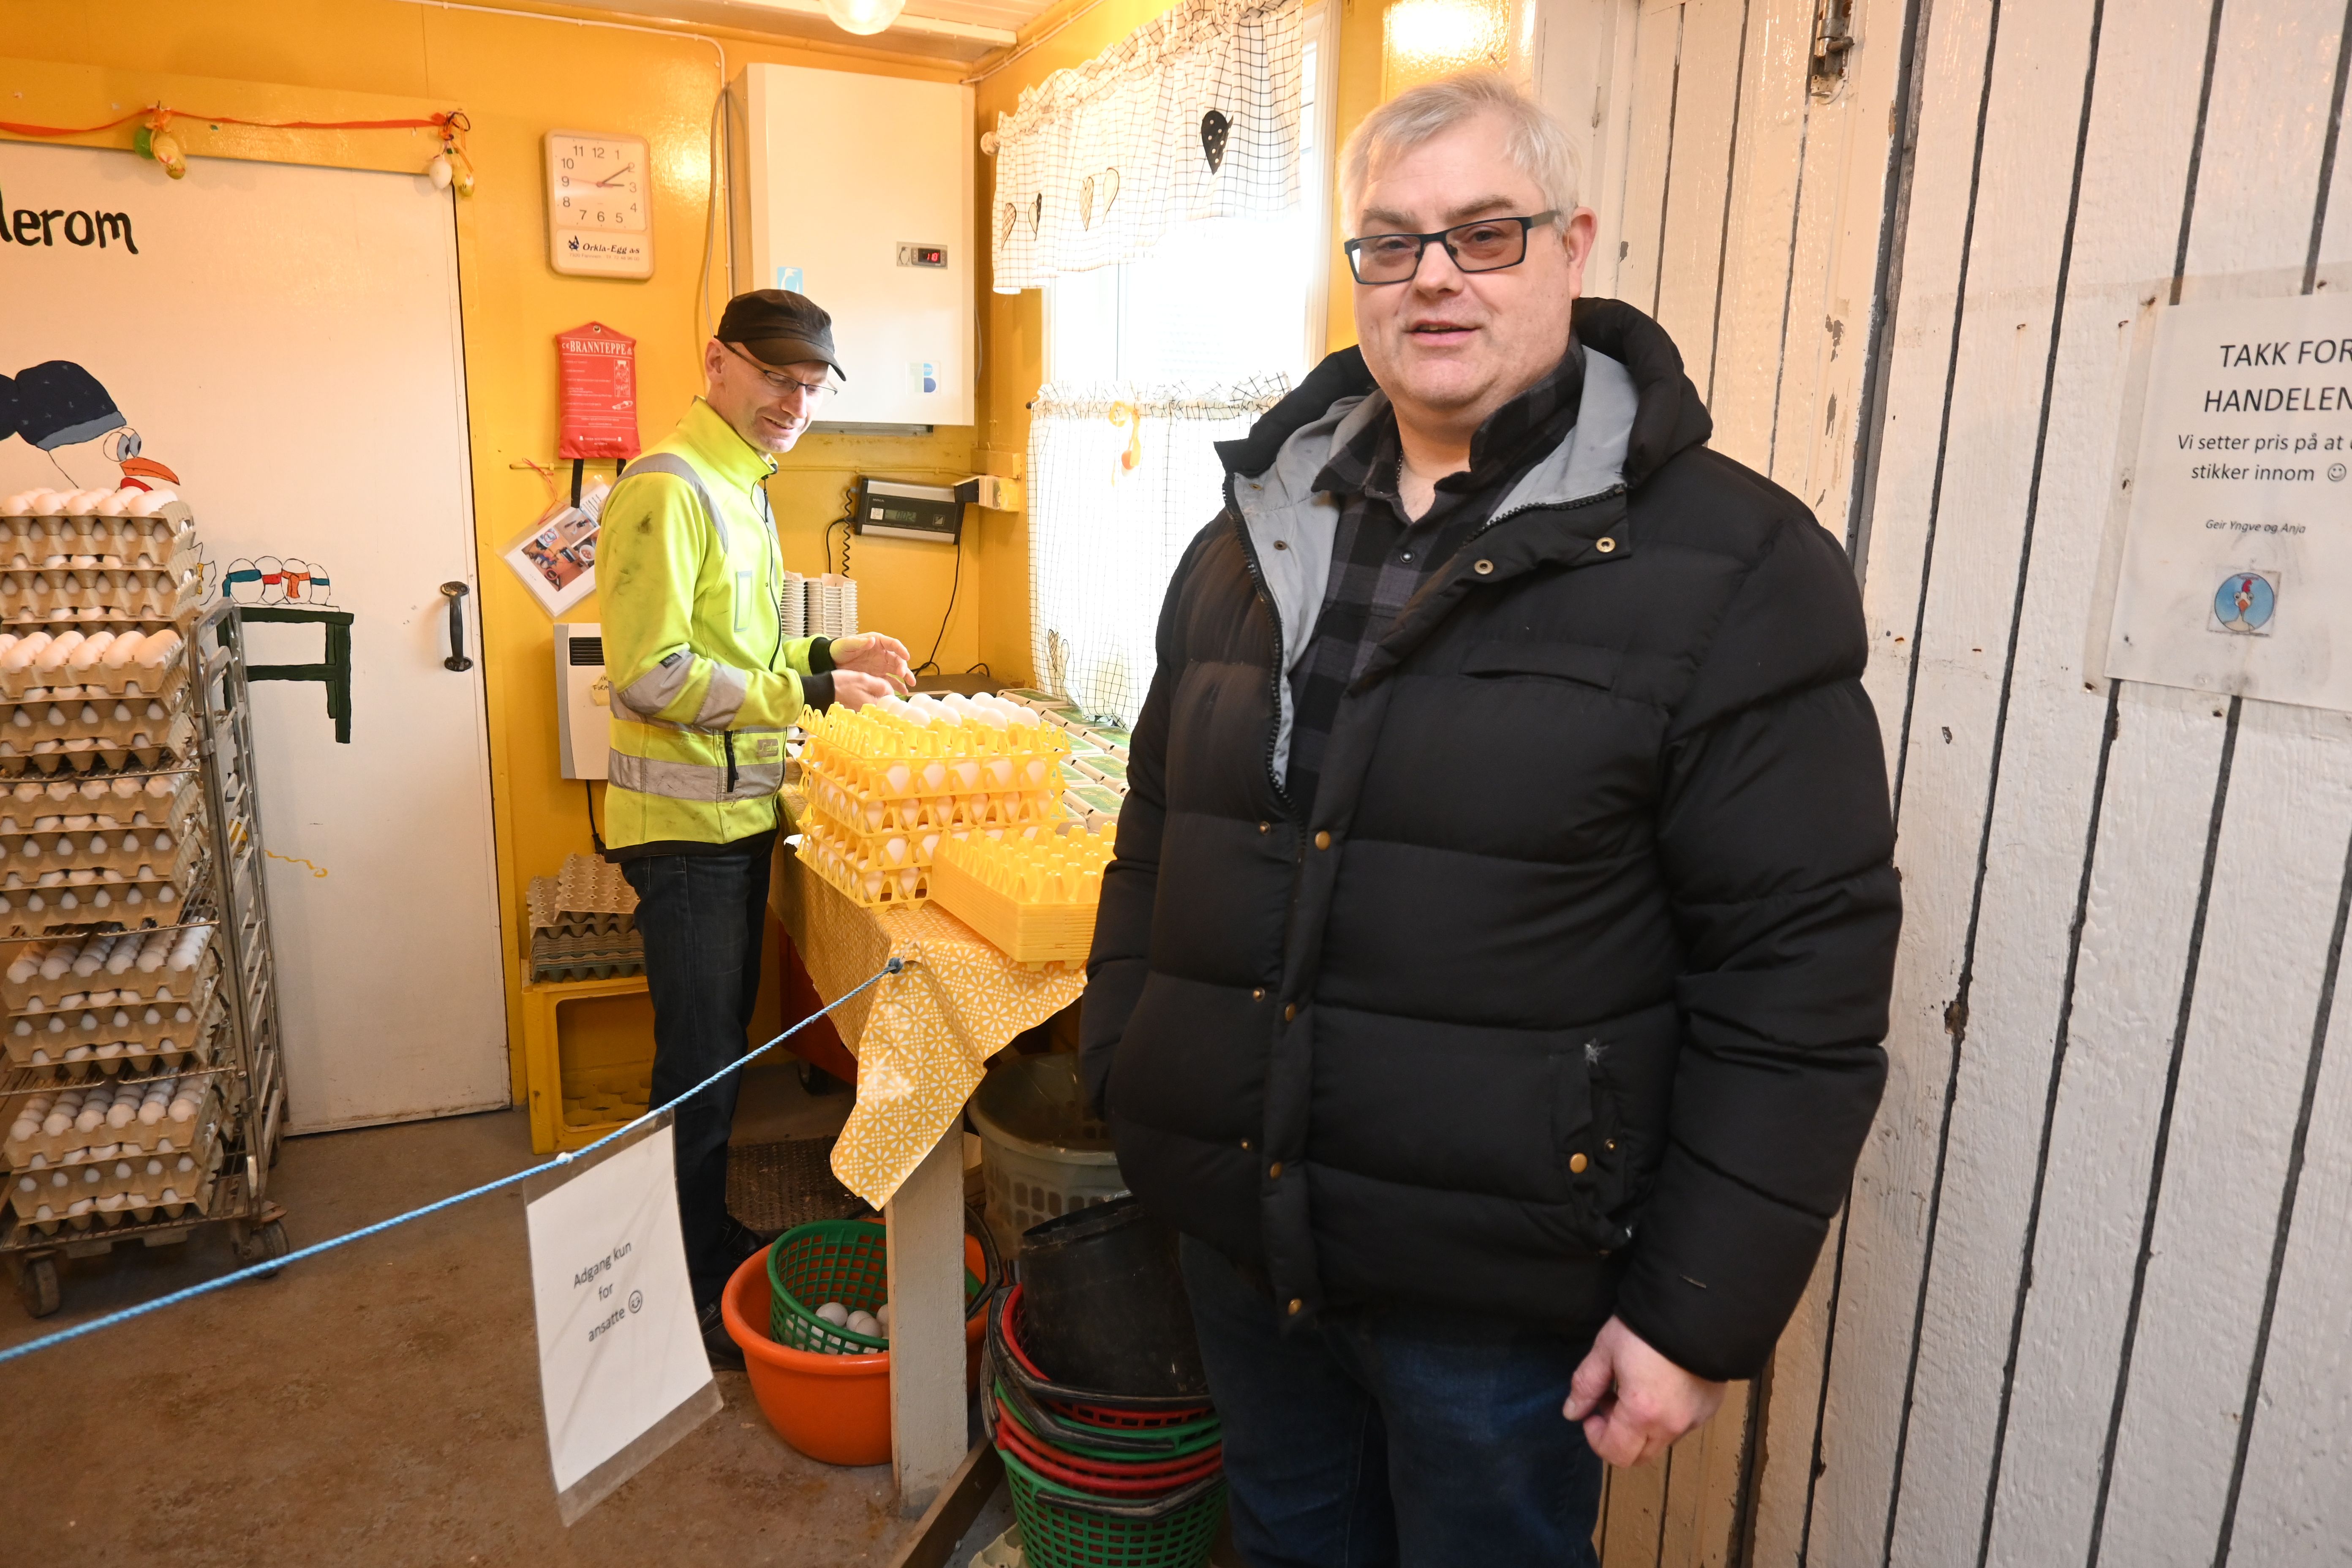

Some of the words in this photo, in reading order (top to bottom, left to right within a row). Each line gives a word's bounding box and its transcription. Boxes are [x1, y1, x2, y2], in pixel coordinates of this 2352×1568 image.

[573, 145, 584, 157] 11
[592, 147, 605, 159] 12
[615, 150, 620, 160] 1
[561, 158, 574, 169] 10
[561, 176, 570, 187] 9
[629, 182, 637, 193] 3
[563, 196, 570, 207] 8
[630, 203, 637, 212] 4
[579, 210, 587, 220] 7
[597, 211, 605, 222] 6
[615, 212, 623, 223] 5
[583, 243, 627, 254] Orkla-Egg
[570, 340, 626, 355] BRANNTEPPE
[2220, 341, 2291, 368] TAKK
[2298, 338, 2352, 365] FOR
[2204, 387, 2352, 412] HANDELEN
[2178, 434, 2194, 450] Vi
[2198, 435, 2250, 450] setter
[2254, 434, 2289, 454] pris
[2294, 433, 2317, 454] på
[2324, 435, 2344, 451] at
[2191, 463, 2249, 480] stikker
[2255, 464, 2315, 482] innom
[2205, 519, 2227, 530] Geir
[2230, 520, 2262, 533] Yngve
[2264, 524, 2278, 534] og
[573, 1255, 611, 1289] Adgang
[613, 1242, 632, 1262] kun
[598, 1283, 614, 1302] for
[588, 1308, 625, 1342] ansatte
